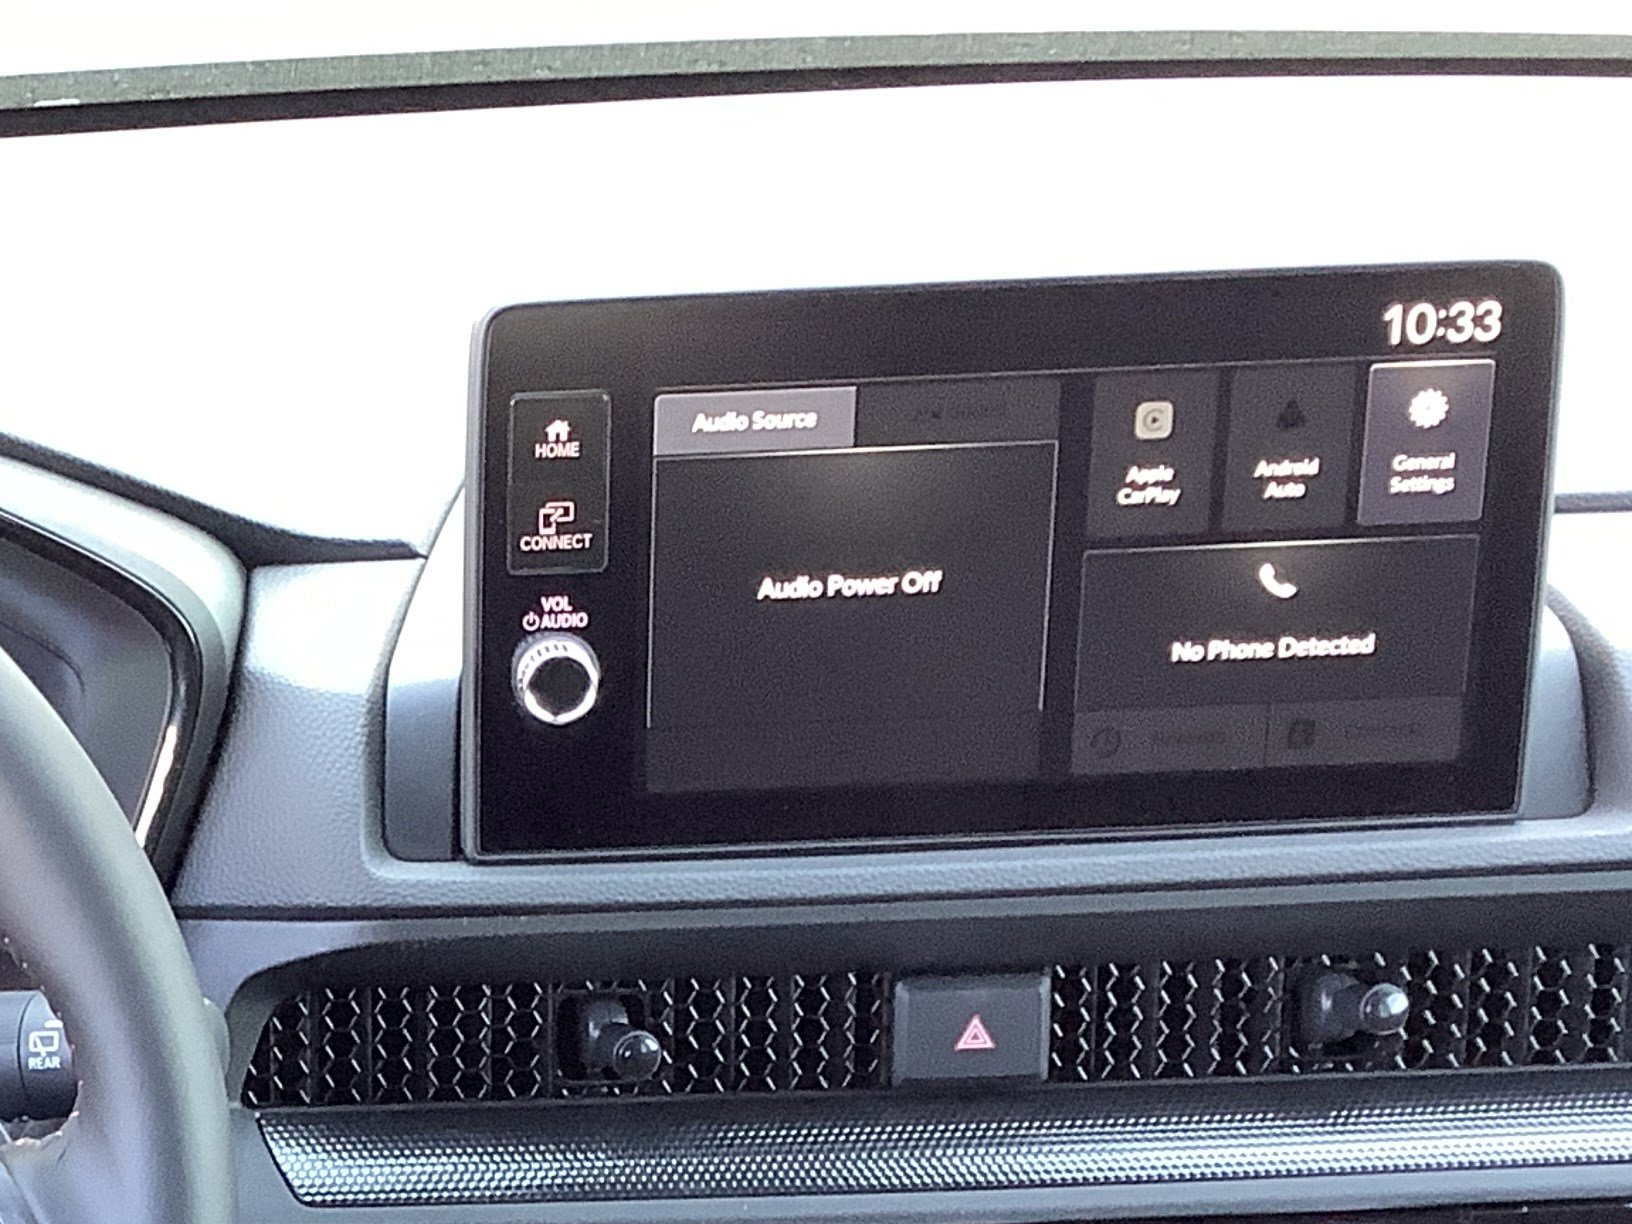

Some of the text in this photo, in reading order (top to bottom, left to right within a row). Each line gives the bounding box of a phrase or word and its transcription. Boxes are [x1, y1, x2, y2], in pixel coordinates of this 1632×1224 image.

[1382, 300, 1503, 347] 10:33
[691, 408, 818, 433] Audio Source
[534, 440, 580, 459] HOME
[1253, 456, 1320, 479] Android
[1391, 452, 1456, 472] General
[1124, 465, 1175, 486] Apple
[1389, 474, 1456, 495] Settings
[1116, 487, 1181, 506] CarPlay
[1263, 481, 1307, 500] Auto
[519, 533, 593, 552] CONNECT
[756, 568, 944, 601] Audio Power Off
[540, 595, 572, 613] VOL
[539, 610, 588, 631] AUDIO
[1170, 632, 1377, 663] No Phone Detected
[28, 1056, 61, 1070] REAR
